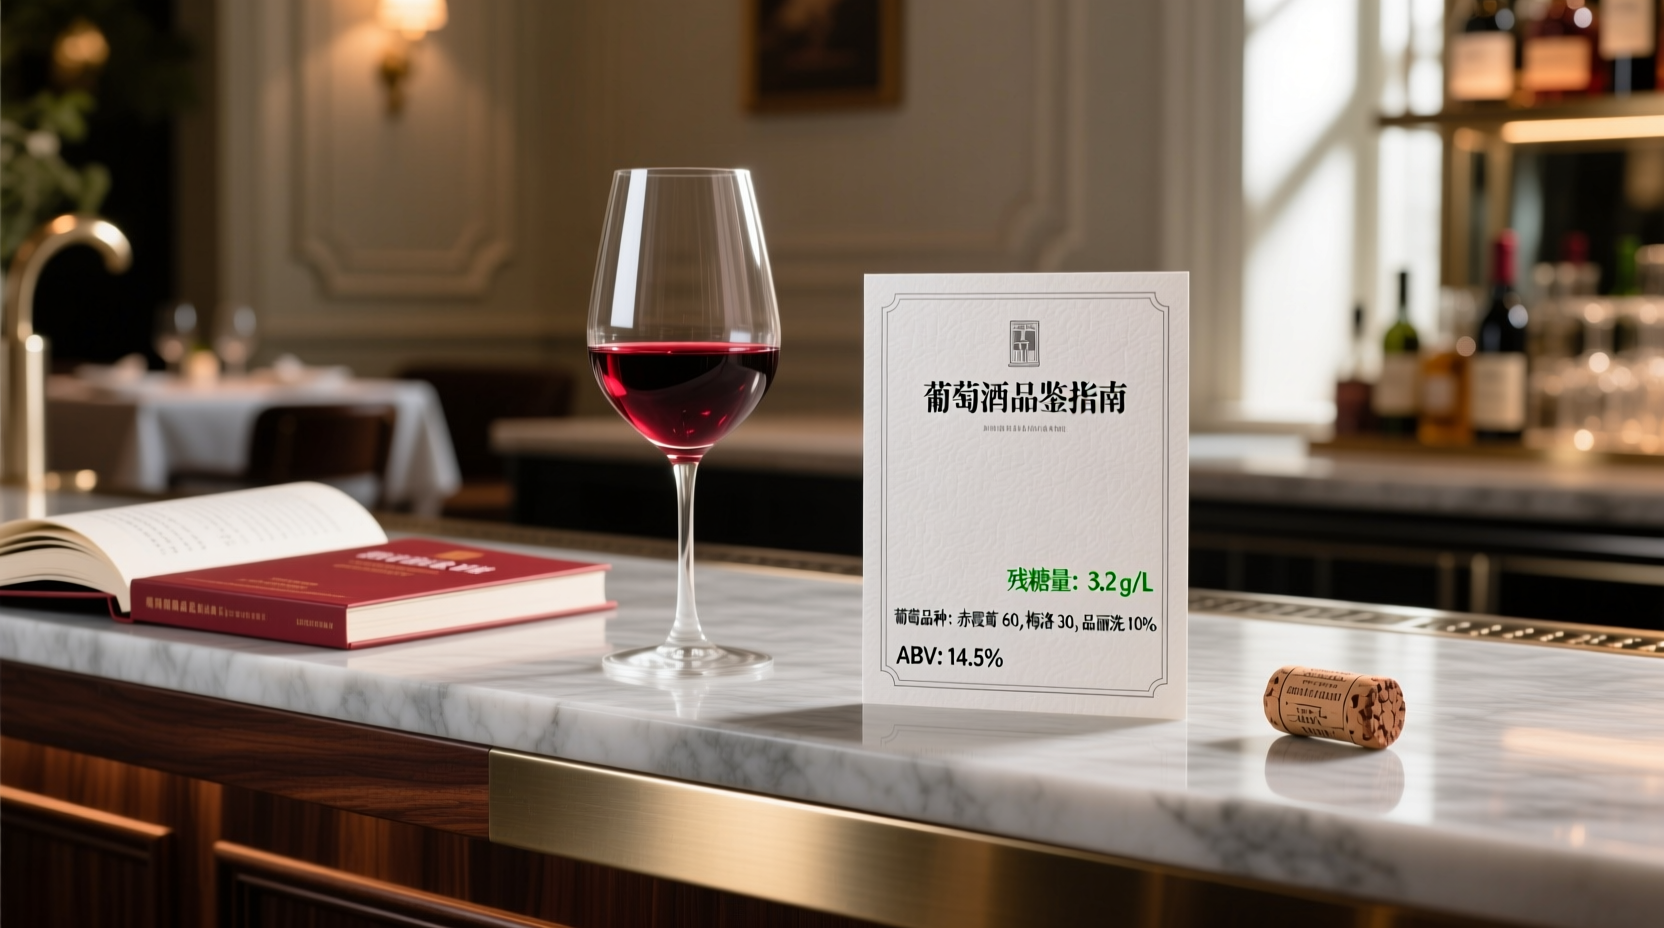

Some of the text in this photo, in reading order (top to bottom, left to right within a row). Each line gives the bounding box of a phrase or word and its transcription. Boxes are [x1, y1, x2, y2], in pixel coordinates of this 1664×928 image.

[924, 380, 1127, 414] 葡萄酒品鉴指南
[896, 646, 1003, 668] ABV: 14.5%
